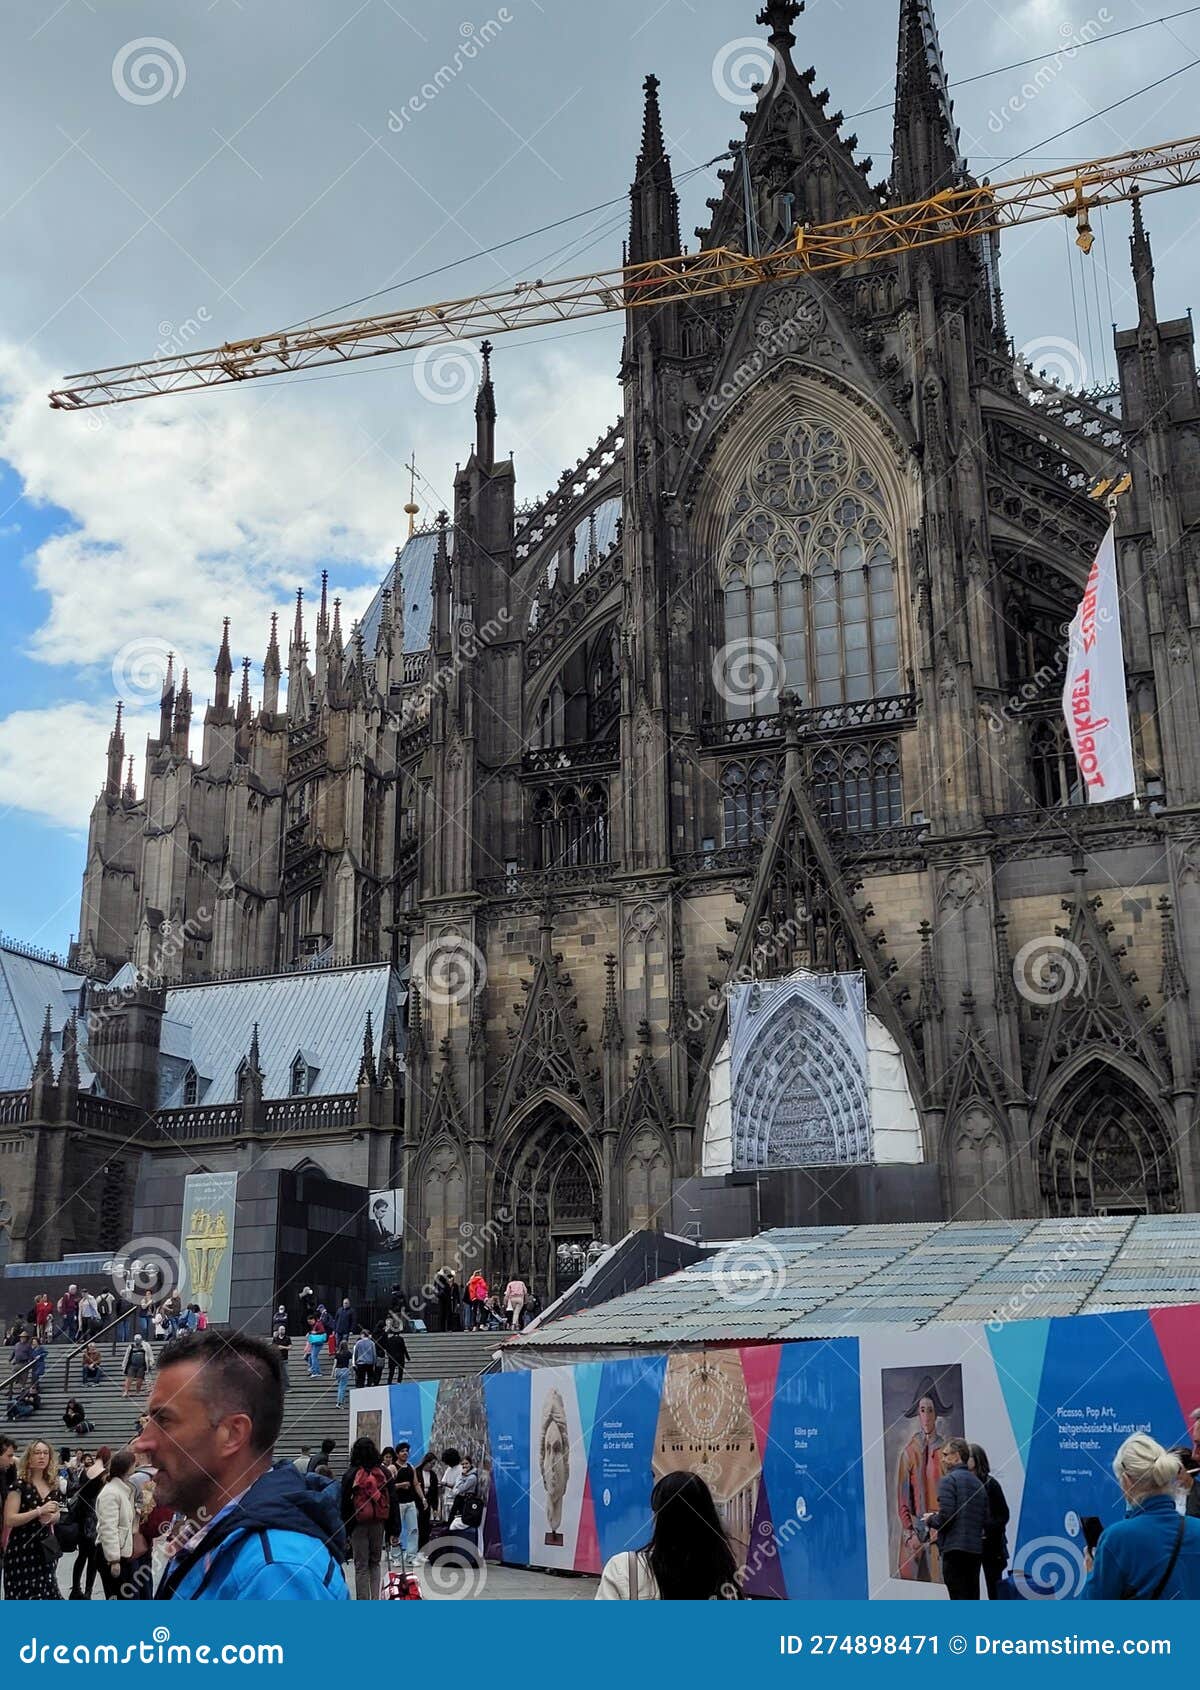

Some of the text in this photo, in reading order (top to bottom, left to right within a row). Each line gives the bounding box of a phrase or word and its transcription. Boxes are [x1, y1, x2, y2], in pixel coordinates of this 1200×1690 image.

[1086, 1406, 1100, 1419] Pop
[1101, 1406, 1117, 1418] Art,
[1113, 1422, 1135, 1433] Kunst
[1135, 1422, 1152, 1433] und
